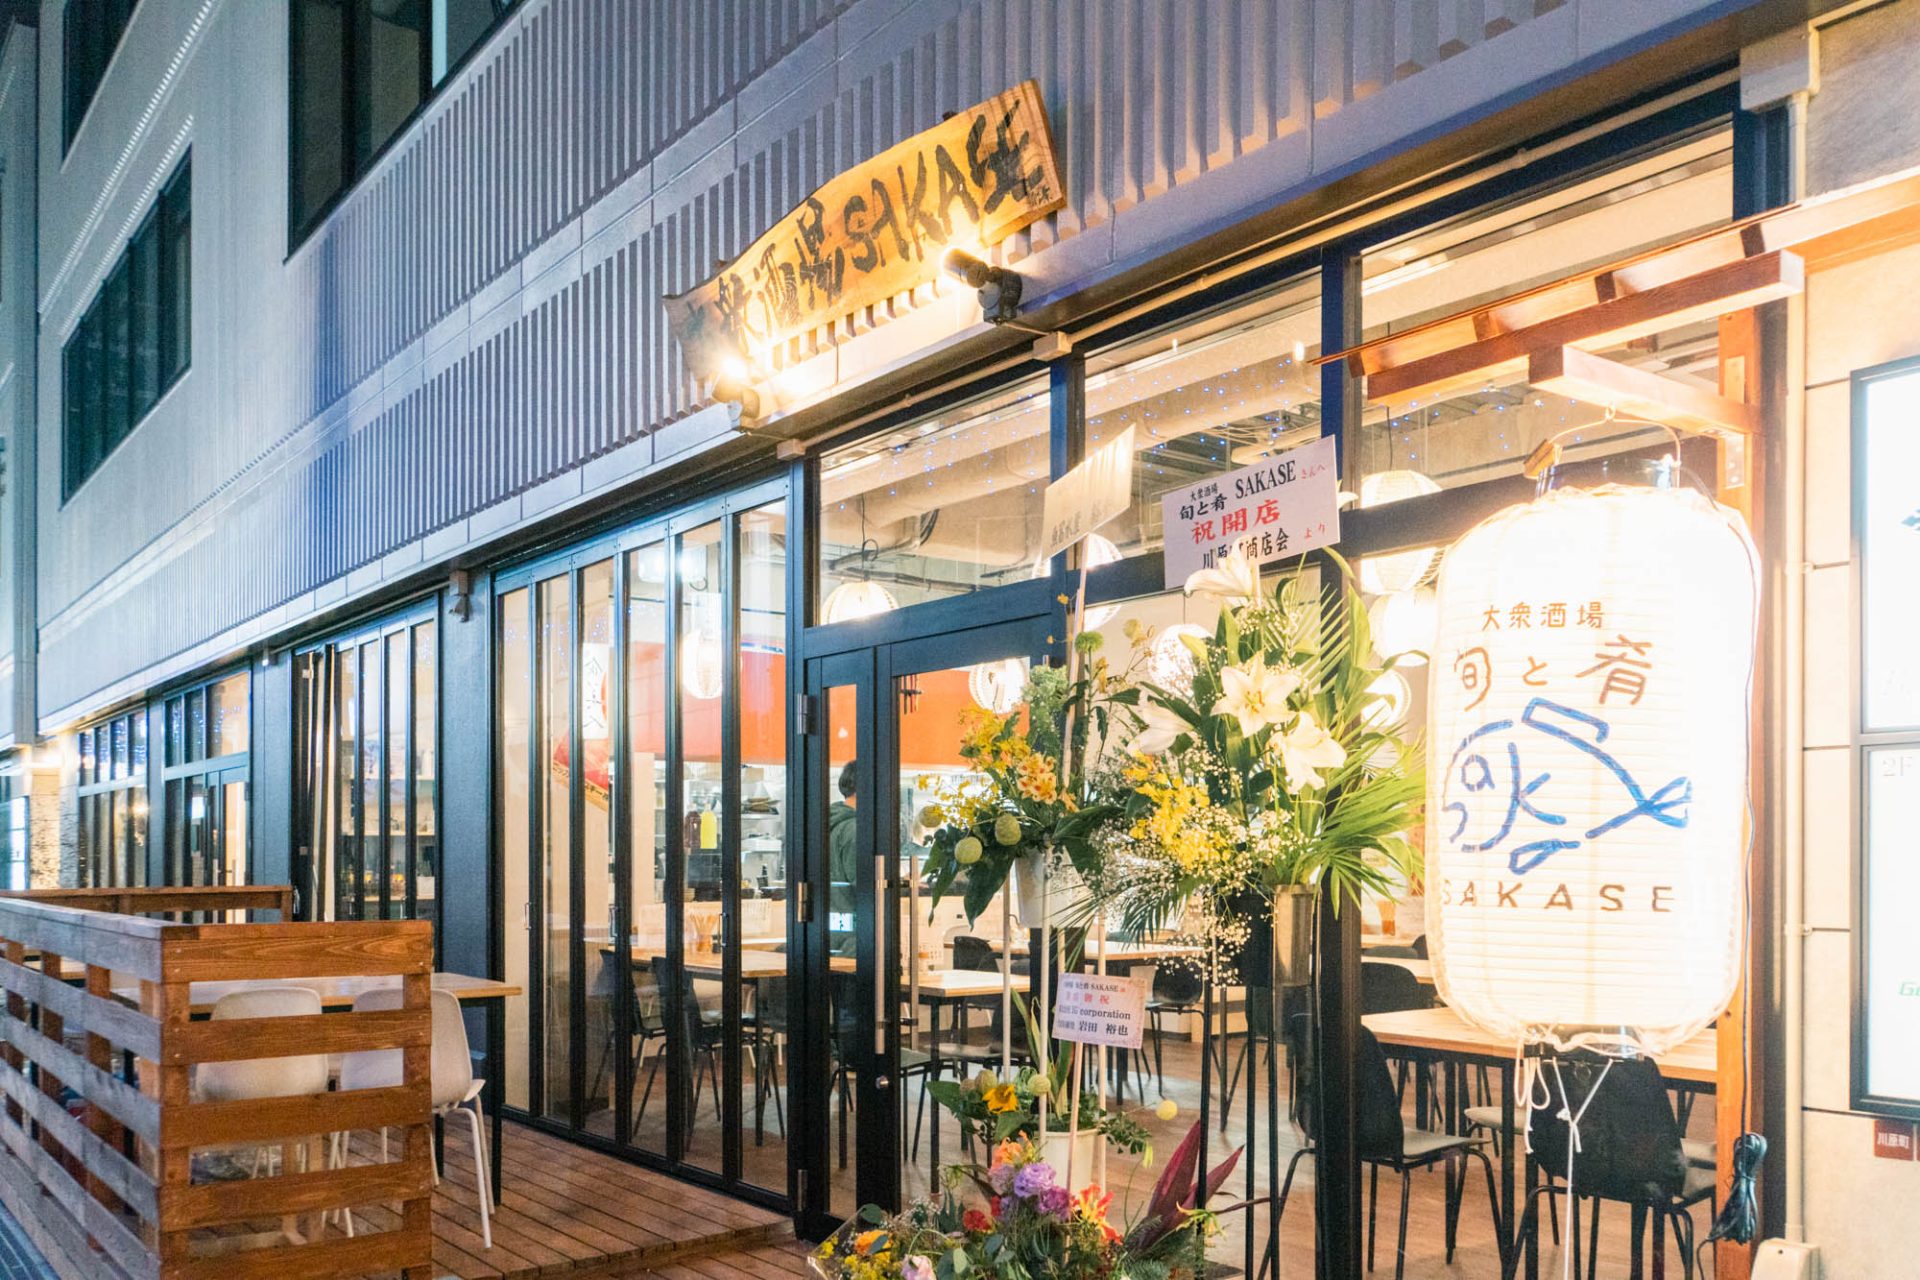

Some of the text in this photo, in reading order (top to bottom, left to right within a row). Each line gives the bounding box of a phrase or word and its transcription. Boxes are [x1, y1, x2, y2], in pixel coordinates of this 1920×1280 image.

[1179, 493, 1228, 521] 旬と肴
[1235, 460, 1297, 499] SAKASE
[1481, 601, 1605, 631] 大衆酒場
[1453, 633, 1654, 713] 旬と肴
[1443, 879, 1675, 913] SAKASE
[1080, 1008, 1131, 1021] corporation
